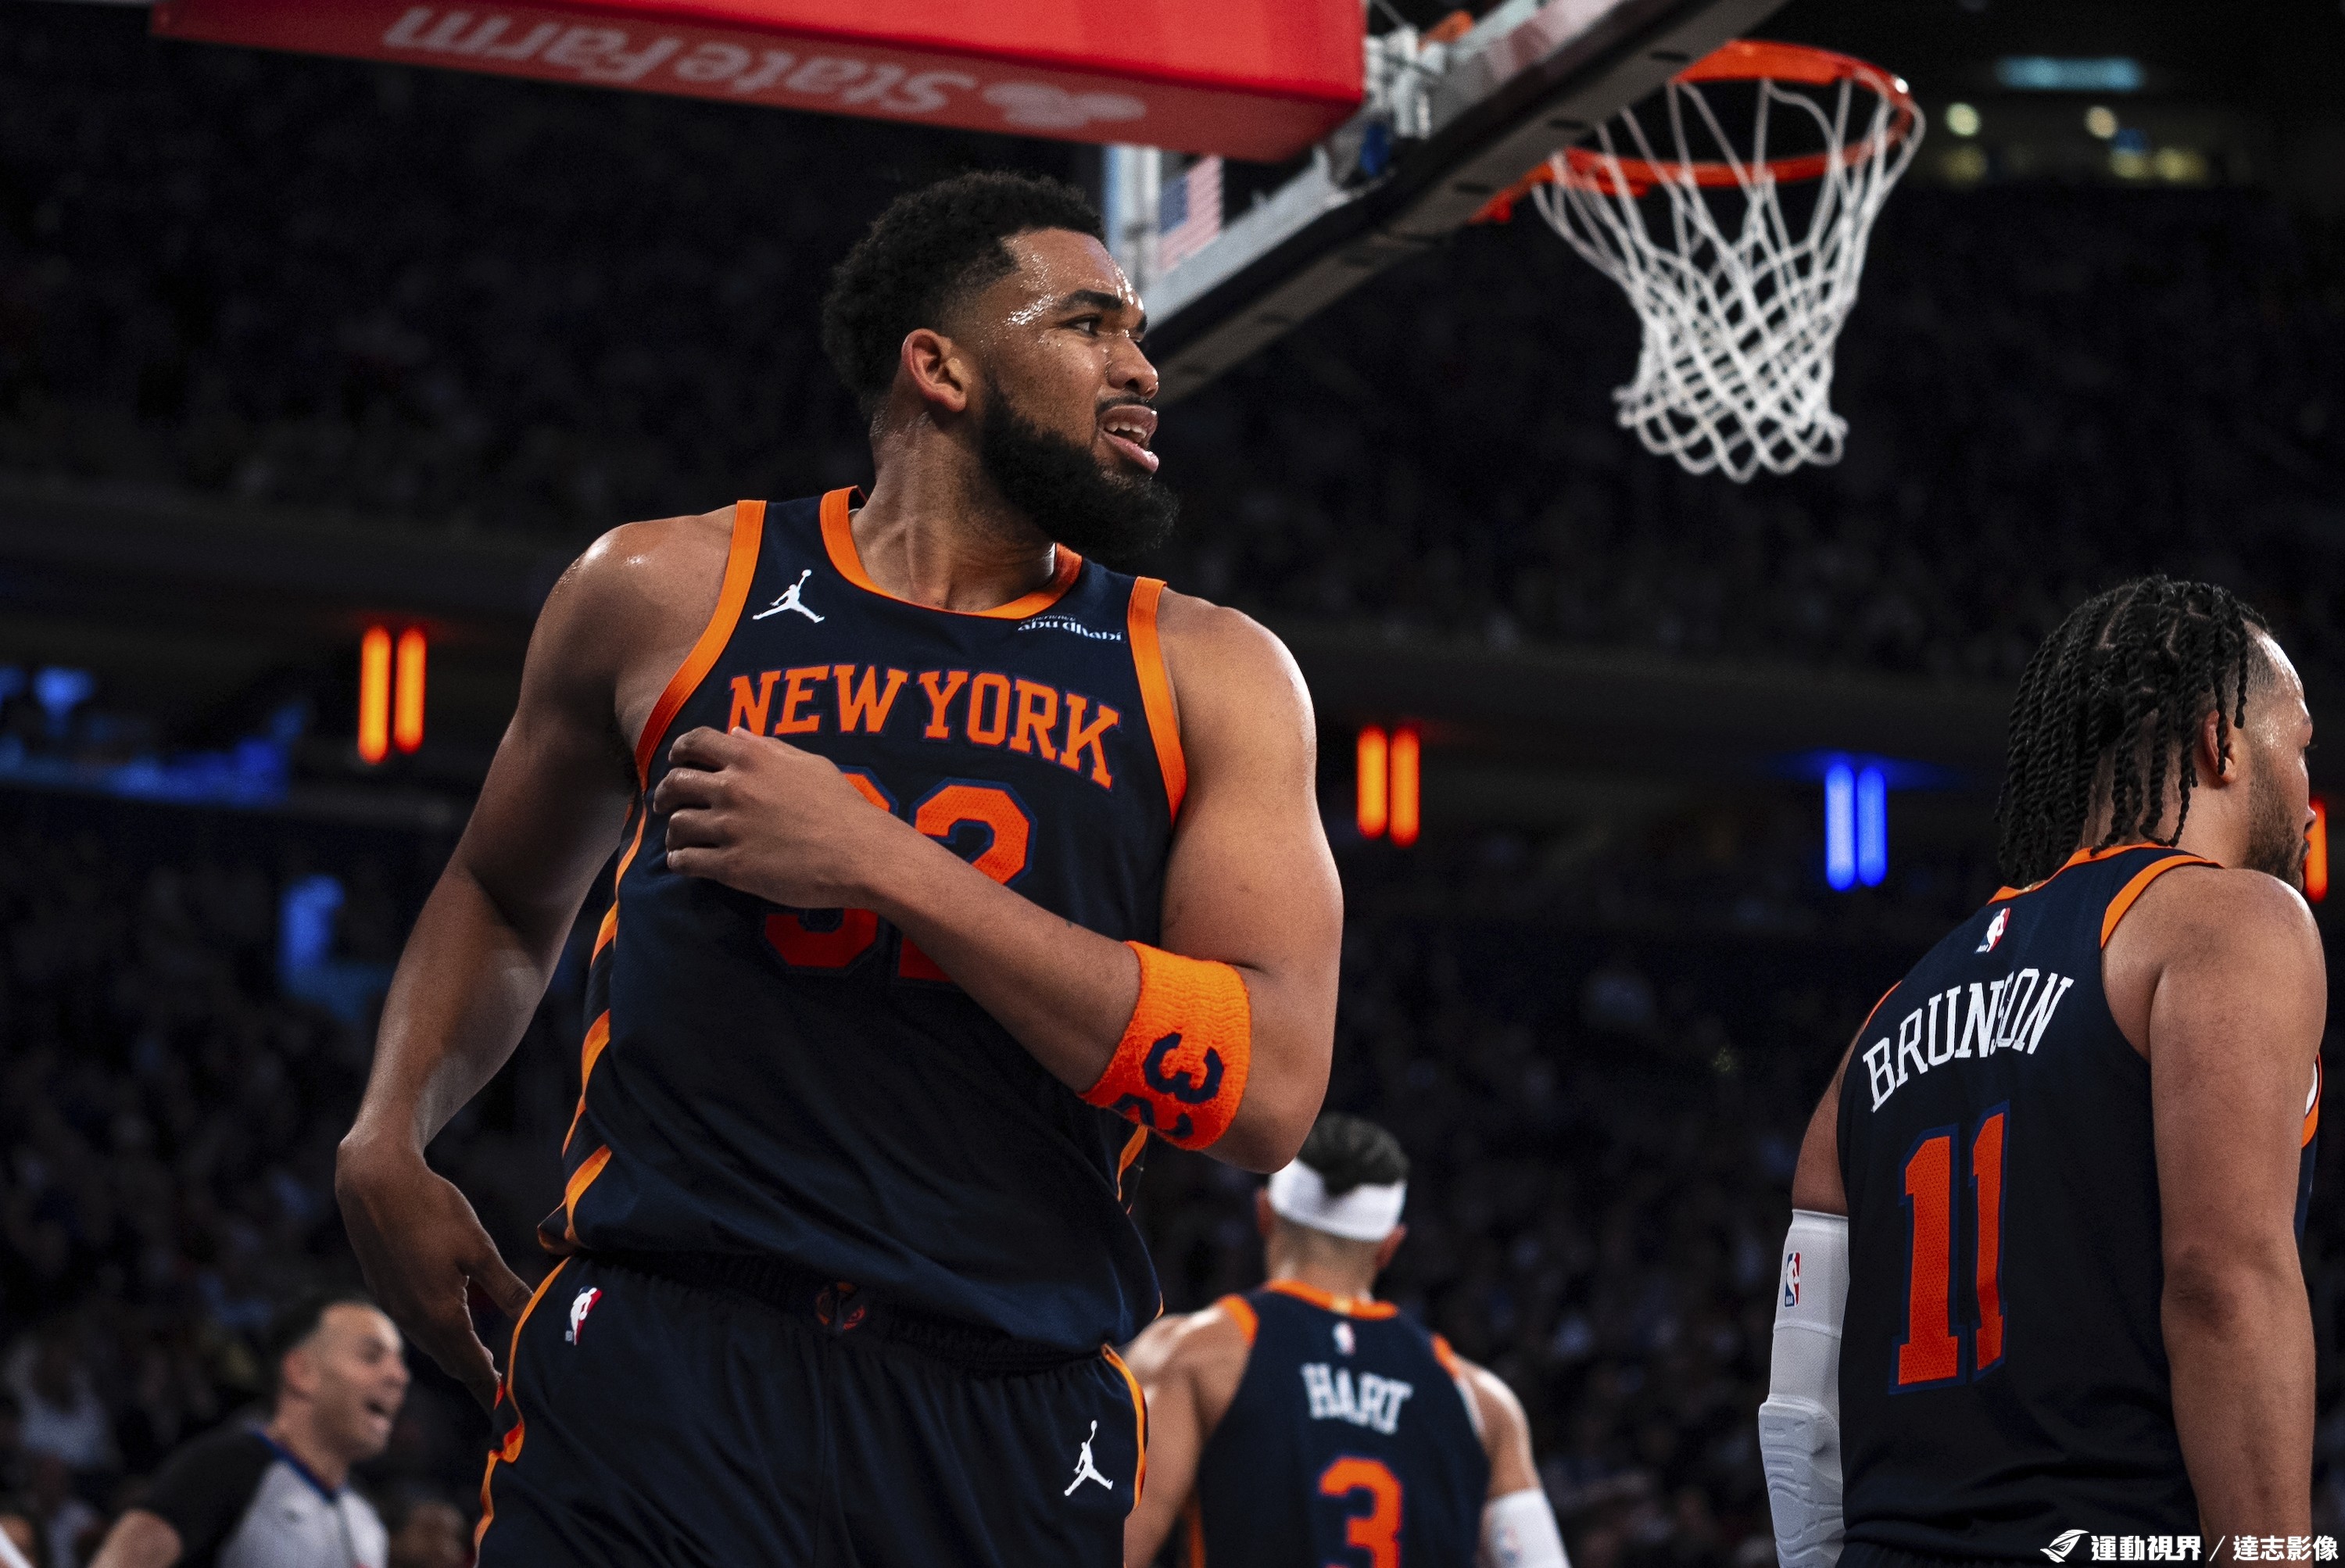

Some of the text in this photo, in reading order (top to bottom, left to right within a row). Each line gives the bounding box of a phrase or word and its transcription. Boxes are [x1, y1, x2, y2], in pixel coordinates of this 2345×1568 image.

[1018, 621, 1122, 641] abu dhabi
[728, 664, 1121, 790] NEW YORK
[1897, 1112, 2005, 1386] 11
[1300, 1362, 1414, 1436] HART
[1319, 1456, 1403, 1568] 3
